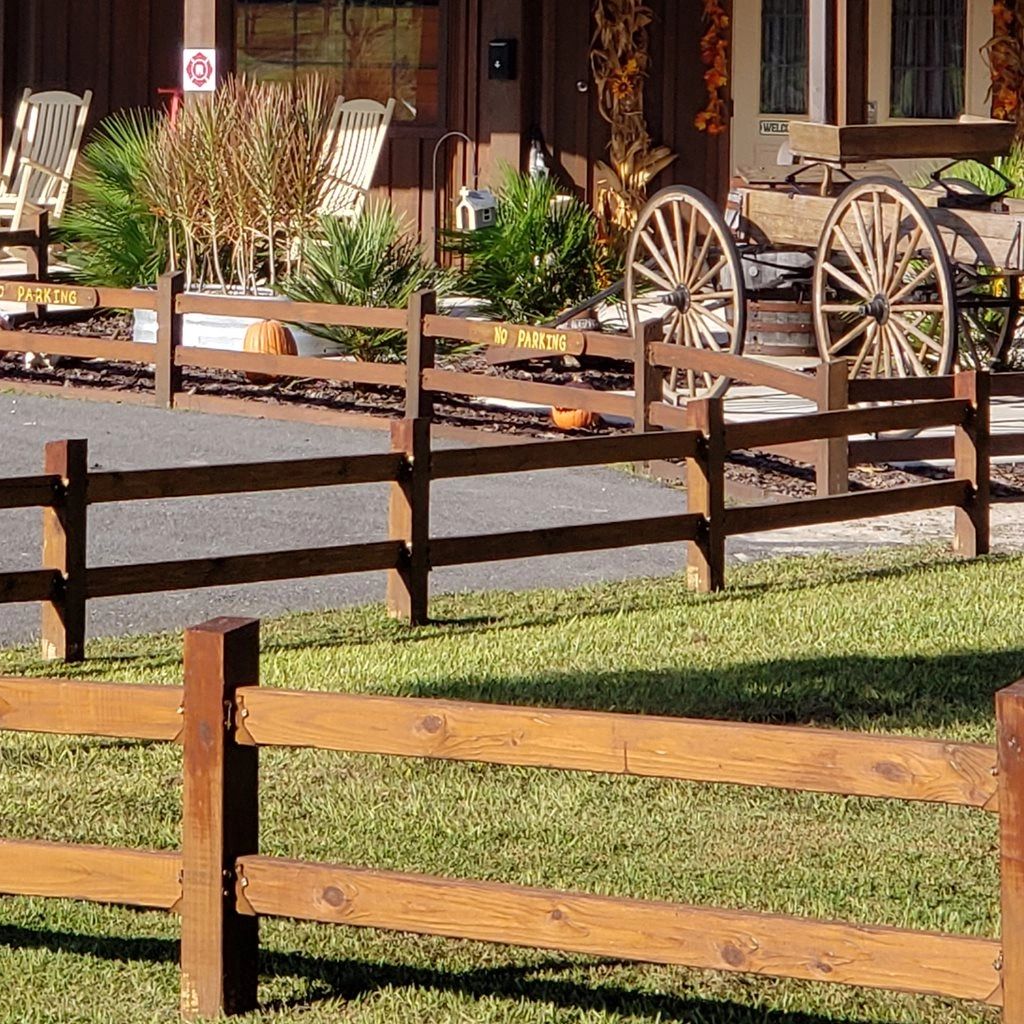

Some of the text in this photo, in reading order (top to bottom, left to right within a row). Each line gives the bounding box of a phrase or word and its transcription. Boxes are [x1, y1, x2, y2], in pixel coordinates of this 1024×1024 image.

[17, 285, 77, 305] PARKING
[494, 326, 567, 351] NO PARKING
